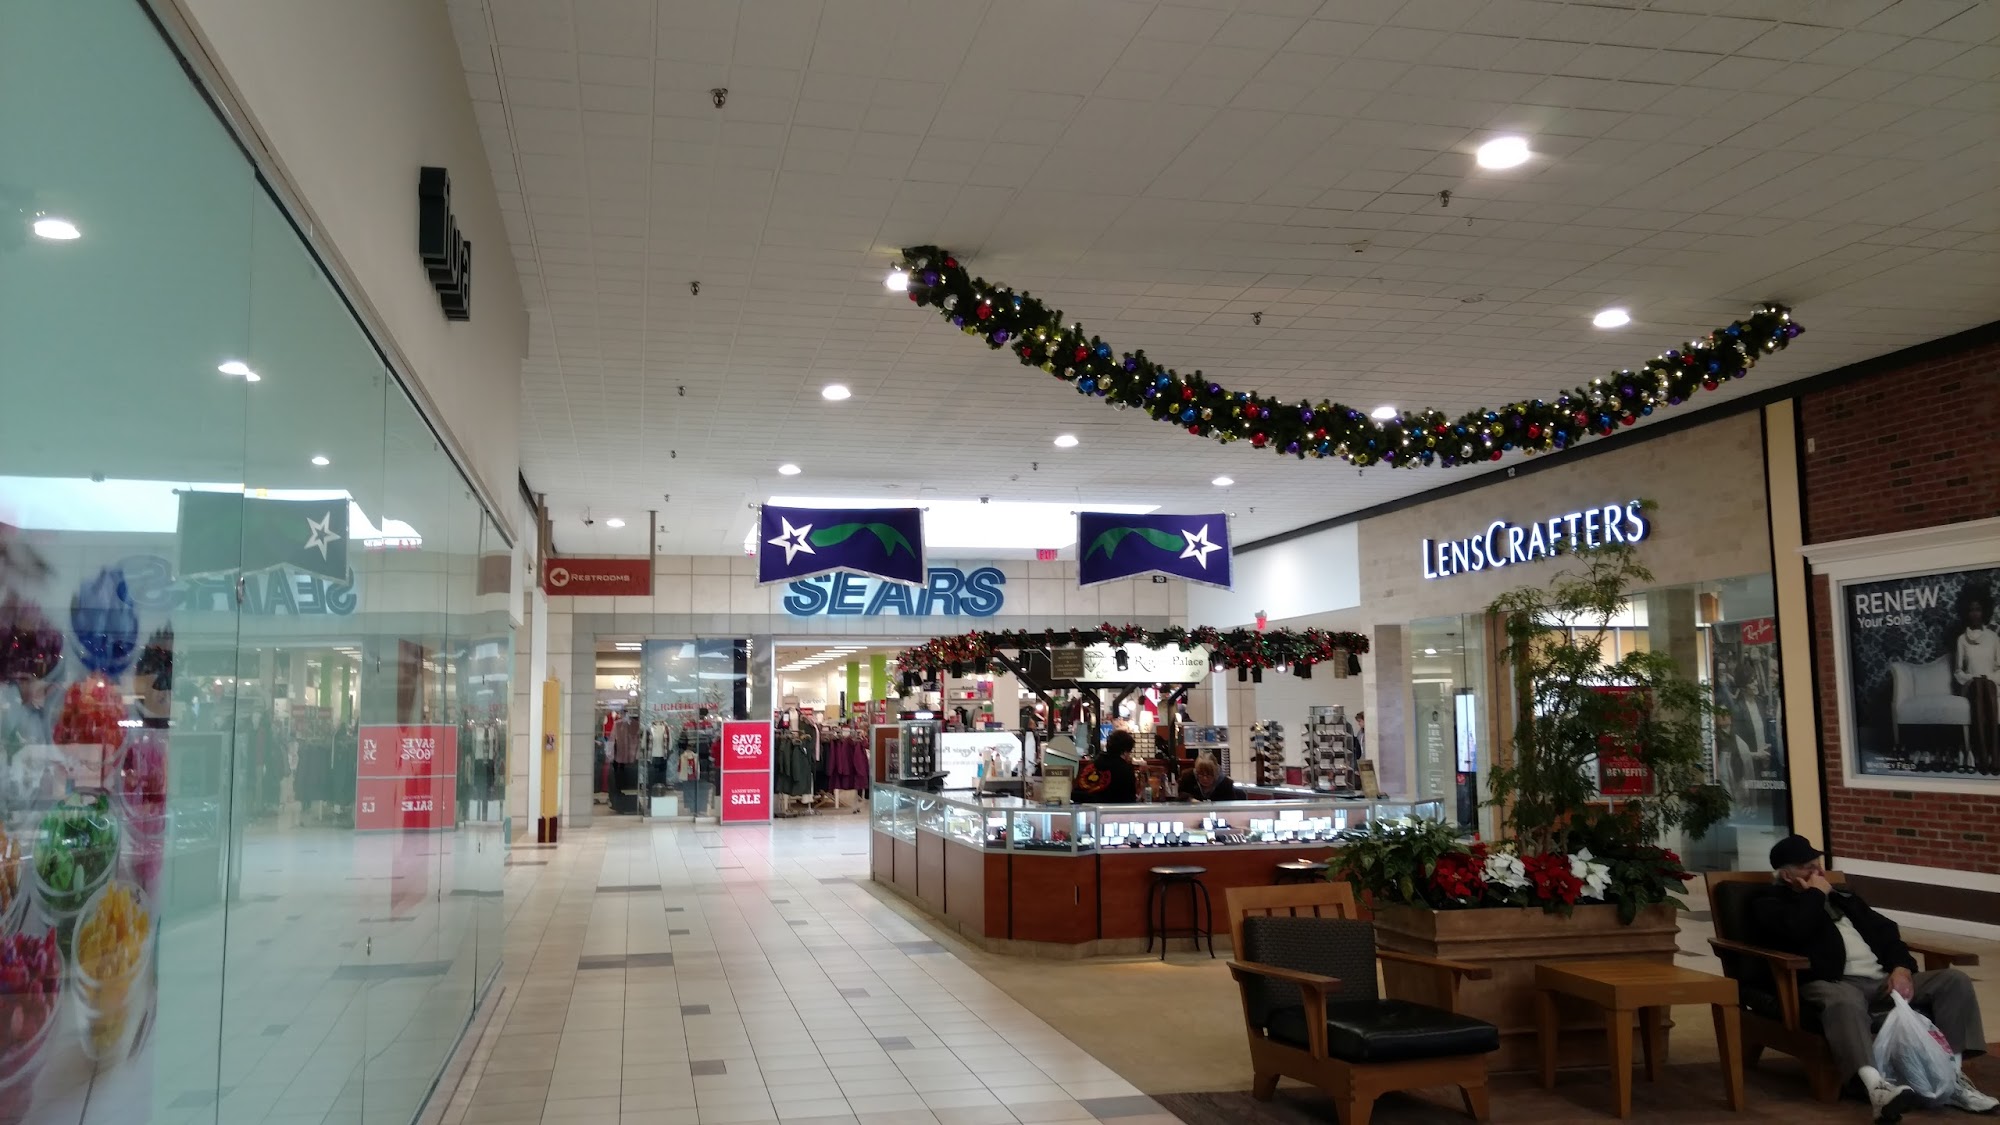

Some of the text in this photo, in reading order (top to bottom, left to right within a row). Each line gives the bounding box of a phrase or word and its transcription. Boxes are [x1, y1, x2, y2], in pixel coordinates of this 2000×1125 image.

[1422, 499, 1647, 580] LENSCRAFTERS
[570, 573, 631, 582] RESTROOMS
[783, 567, 1007, 617] SEARS
[1855, 585, 1940, 615] RENEW
[1857, 612, 1912, 629] Your Sole
[732, 734, 762, 745] SAVE
[737, 744, 762, 756] 60%
[731, 794, 761, 805] SALE
